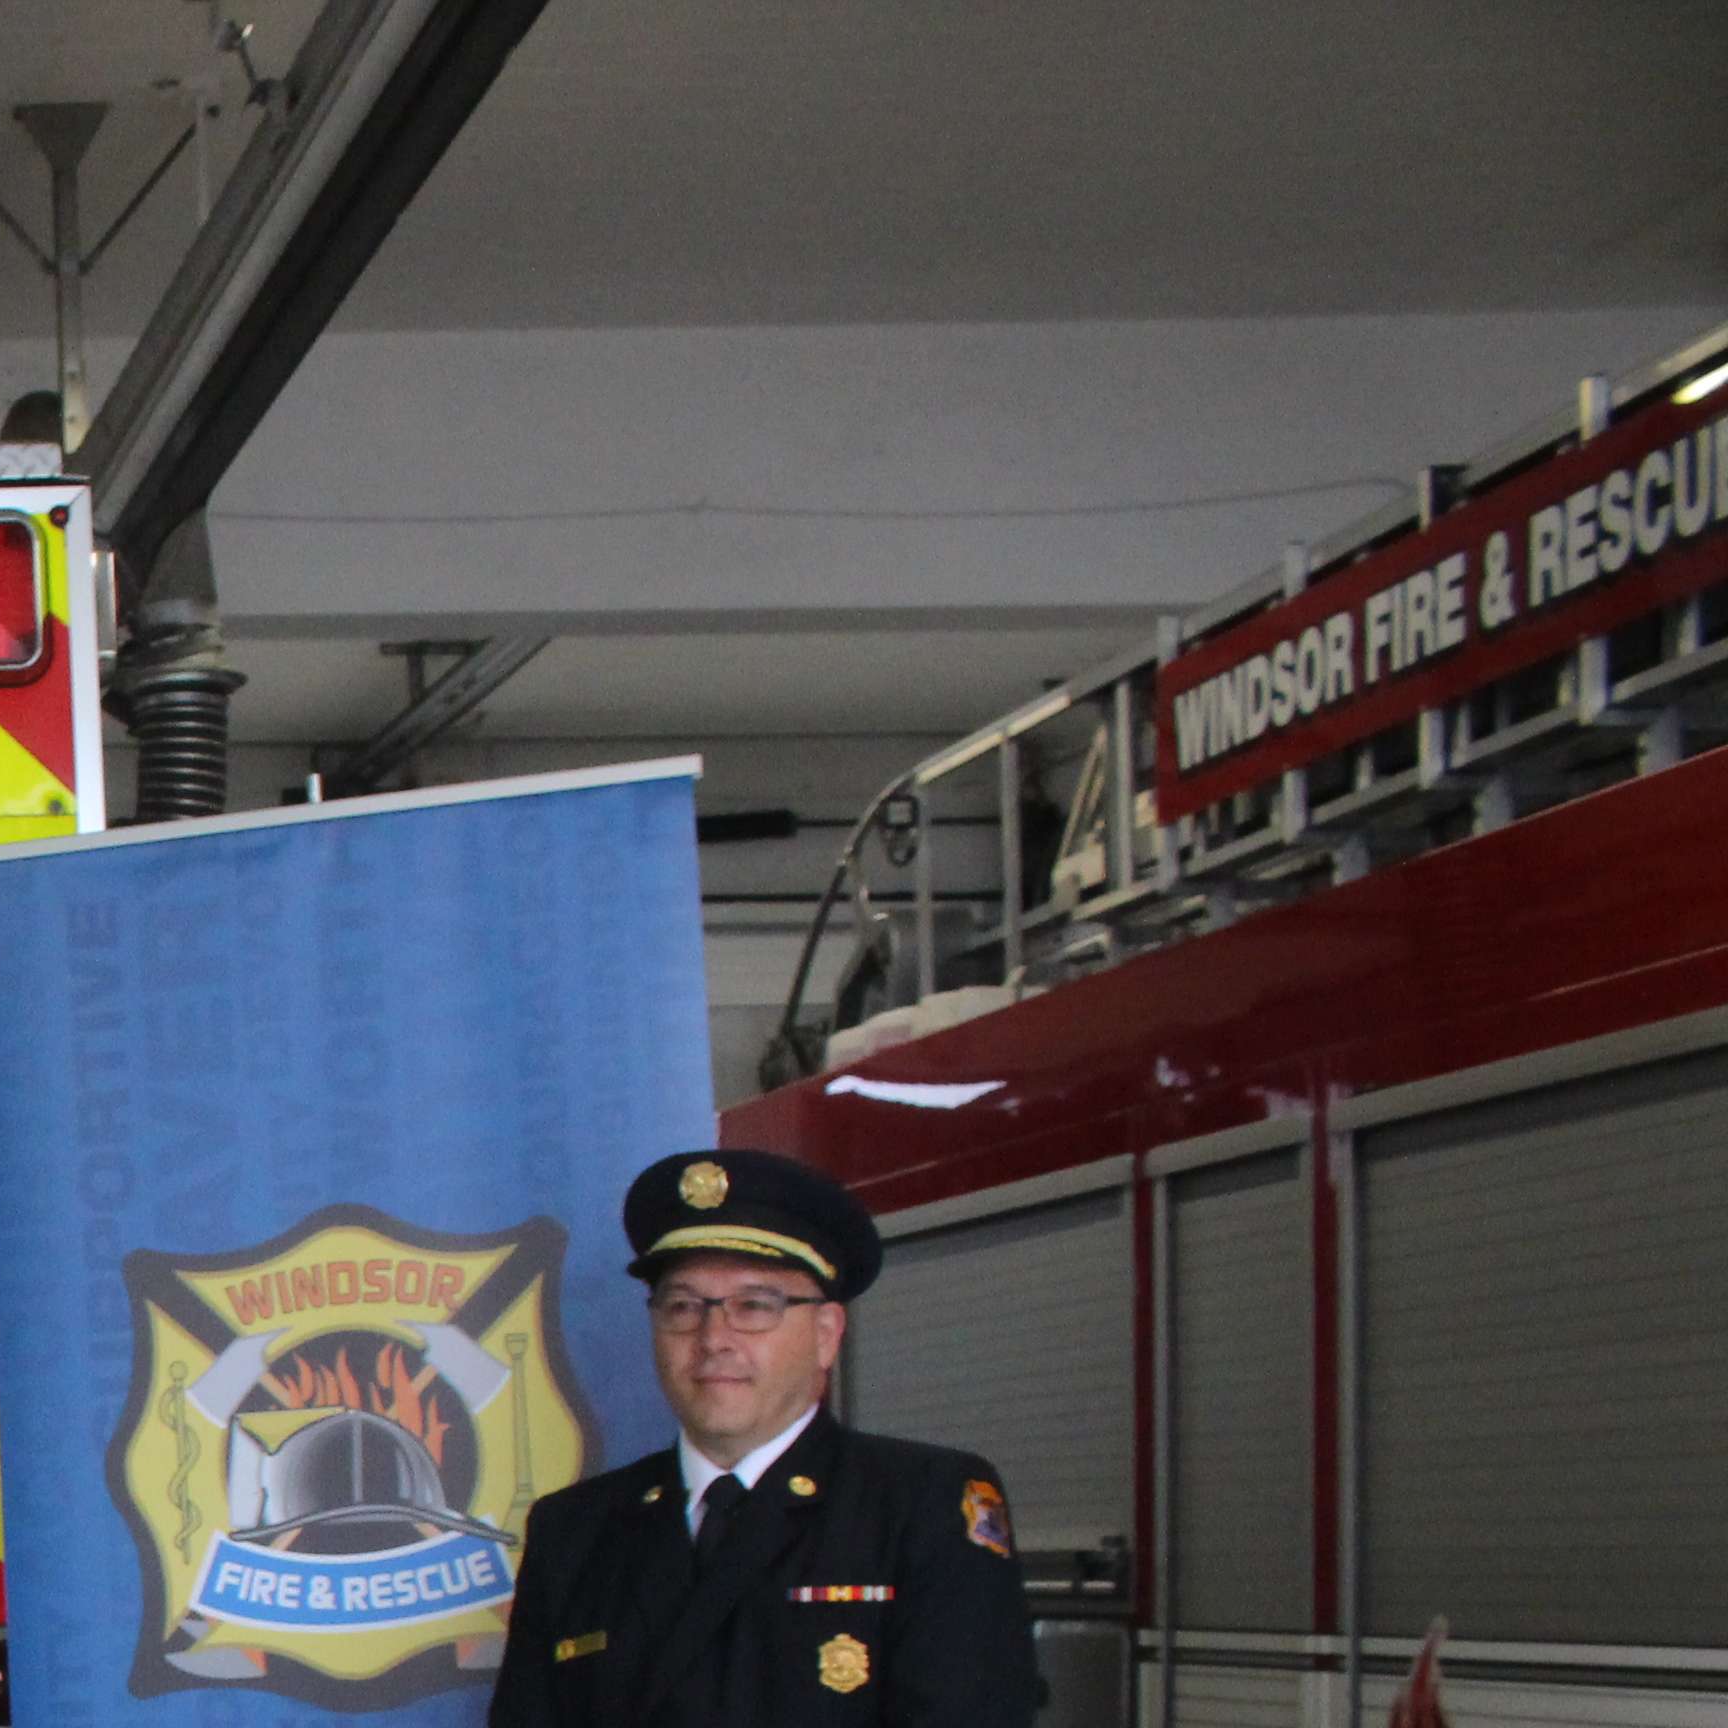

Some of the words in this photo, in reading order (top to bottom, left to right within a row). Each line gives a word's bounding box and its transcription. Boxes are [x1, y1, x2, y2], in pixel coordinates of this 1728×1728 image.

[1174, 611, 1355, 773] WINDSOR
[1365, 552, 1467, 685] FIRE
[1479, 531, 1517, 630] &
[225, 1259, 466, 1326] WINDSOR
[215, 1561, 301, 1609] FIRE
[307, 1575, 337, 1611] &
[344, 1550, 497, 1611] RESCUE
